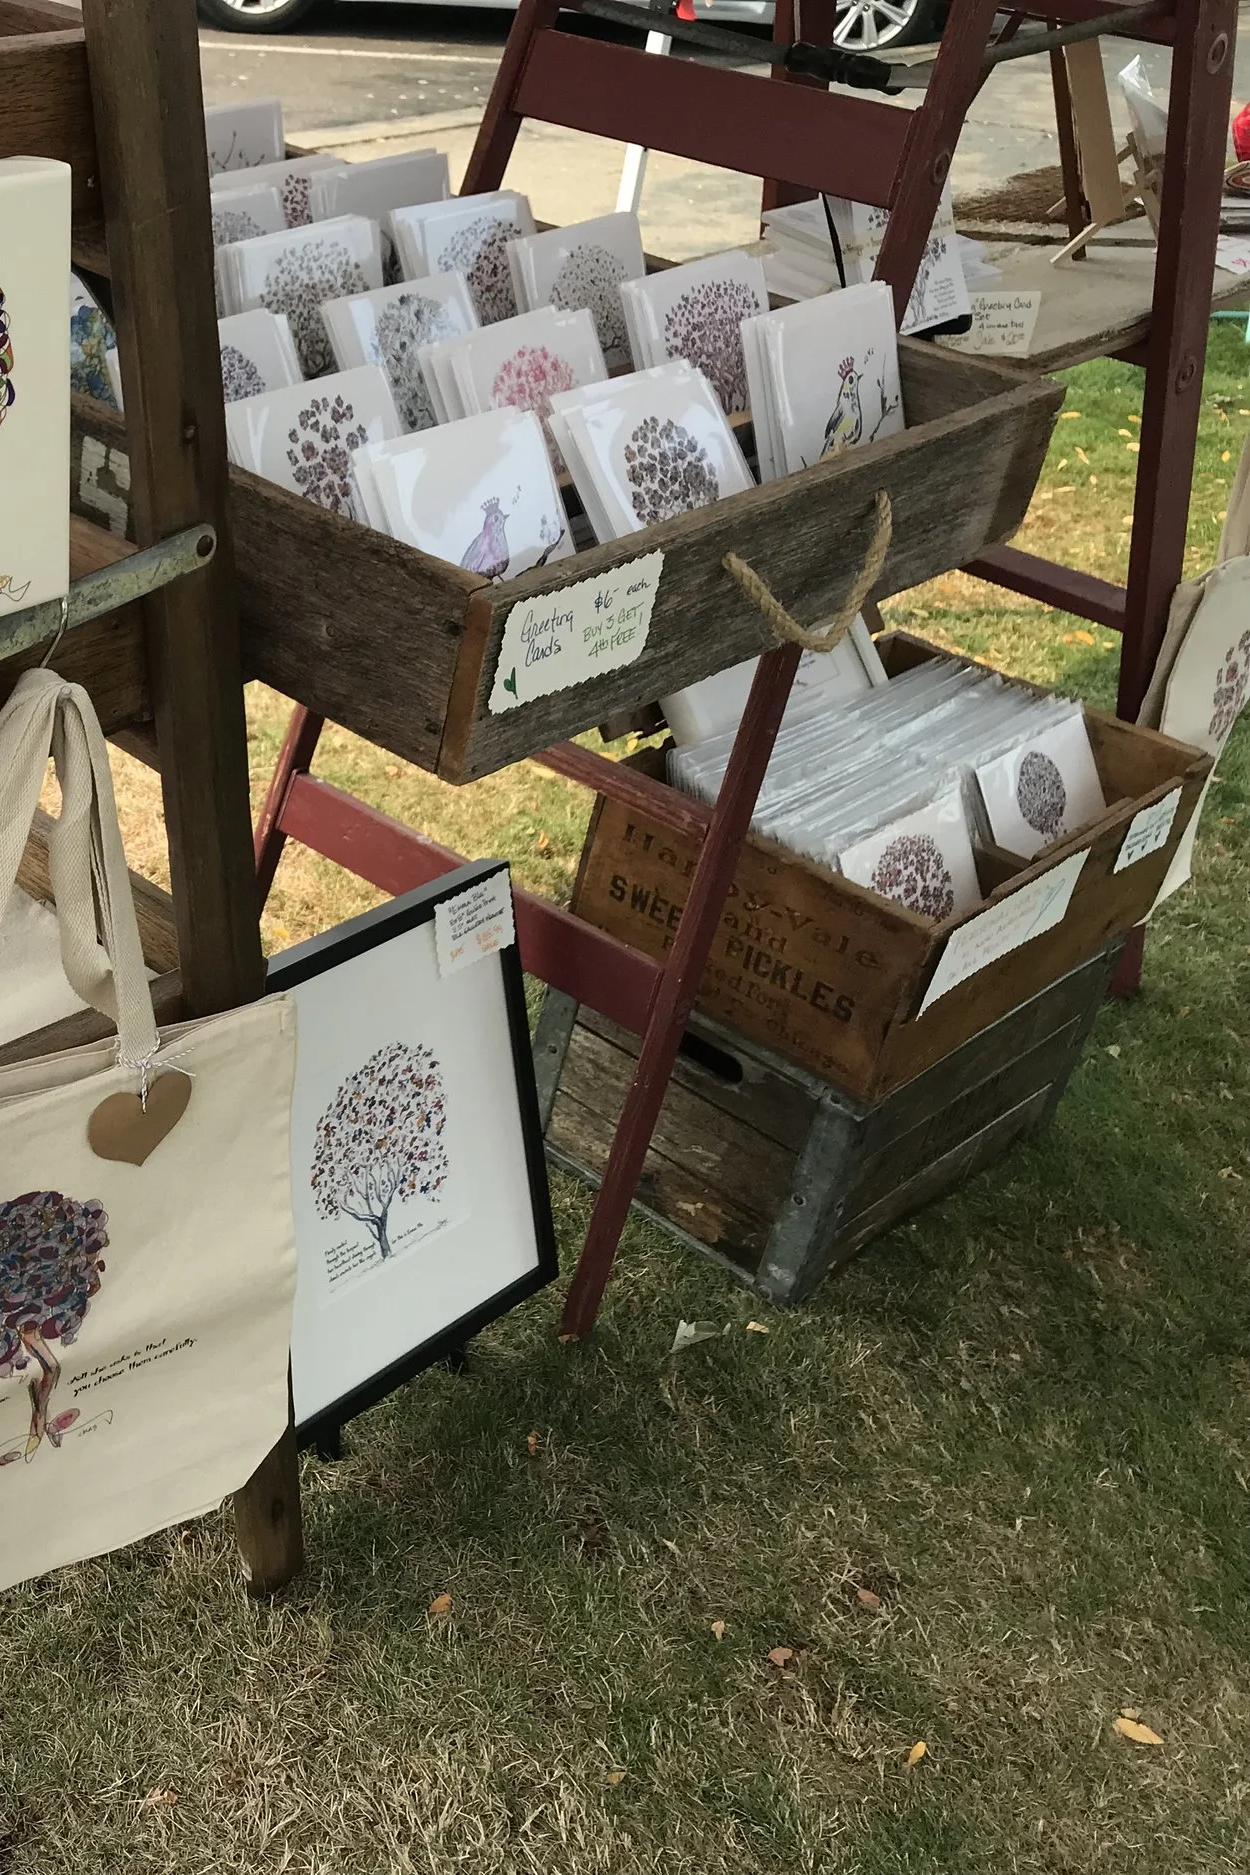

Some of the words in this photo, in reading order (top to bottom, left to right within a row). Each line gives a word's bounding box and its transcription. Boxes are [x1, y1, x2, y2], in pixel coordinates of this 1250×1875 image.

[627, 578, 651, 596] each
[520, 608, 574, 643] Greeting
[607, 614, 615, 629] 3
[525, 636, 562, 667] Cards
[609, 875, 685, 932] SWEE
[725, 936, 855, 1022] PICKLES
[73, 1383, 91, 1397] you
[129, 1356, 151, 1371] them
